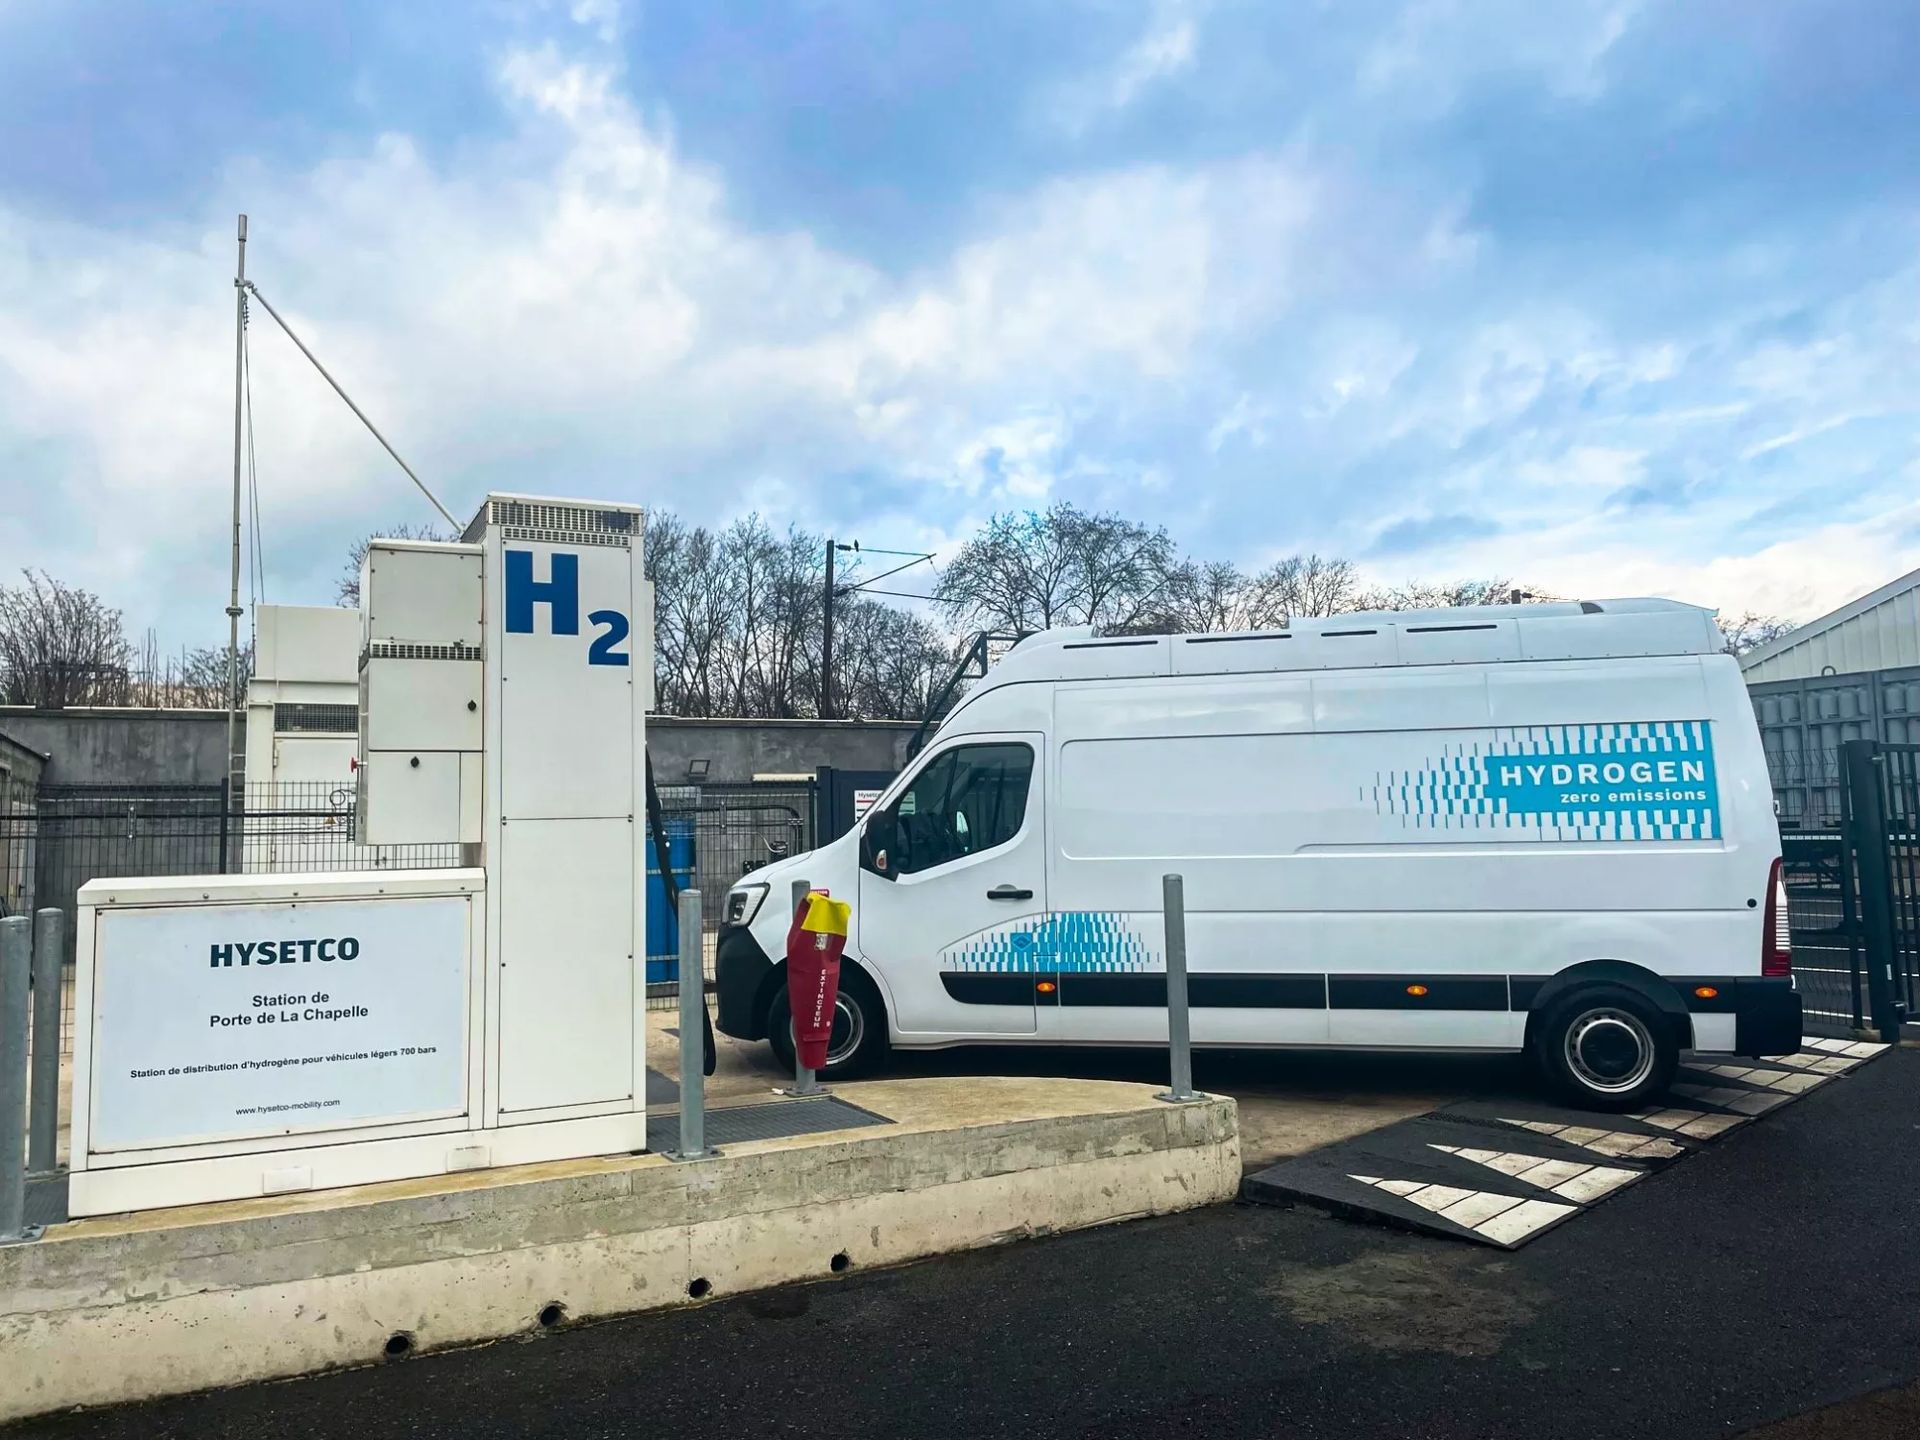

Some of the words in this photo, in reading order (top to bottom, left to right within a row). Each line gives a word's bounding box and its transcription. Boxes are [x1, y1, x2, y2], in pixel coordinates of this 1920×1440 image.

[1501, 760, 1705, 787] HYDROGEN
[1560, 792, 1600, 804] zero
[1608, 788, 1706, 802] emissions
[210, 937, 360, 968] HYSETCO
[252, 993, 306, 1007] Station
[311, 991, 330, 1004] de
[813, 969, 827, 1028] EXTINCTEUR
[210, 1013, 252, 1027] Porte
[257, 1012, 275, 1024] de
[281, 1010, 299, 1022] La
[303, 1005, 369, 1021] Chapelle
[130, 1068, 166, 1078] Station
[168, 1066, 180, 1075] de
[183, 1062, 239, 1074] distribution
[241, 1057, 300, 1069] d'hydrogène
[301, 1055, 323, 1065] pour
[325, 1052, 369, 1062] véhicules
[370, 1049, 398, 1059] légers
[400, 1047, 416, 1056] 700
[417, 1046, 437, 1054] bars
[235, 1100, 341, 1115] www.hysetco-mobility.com
